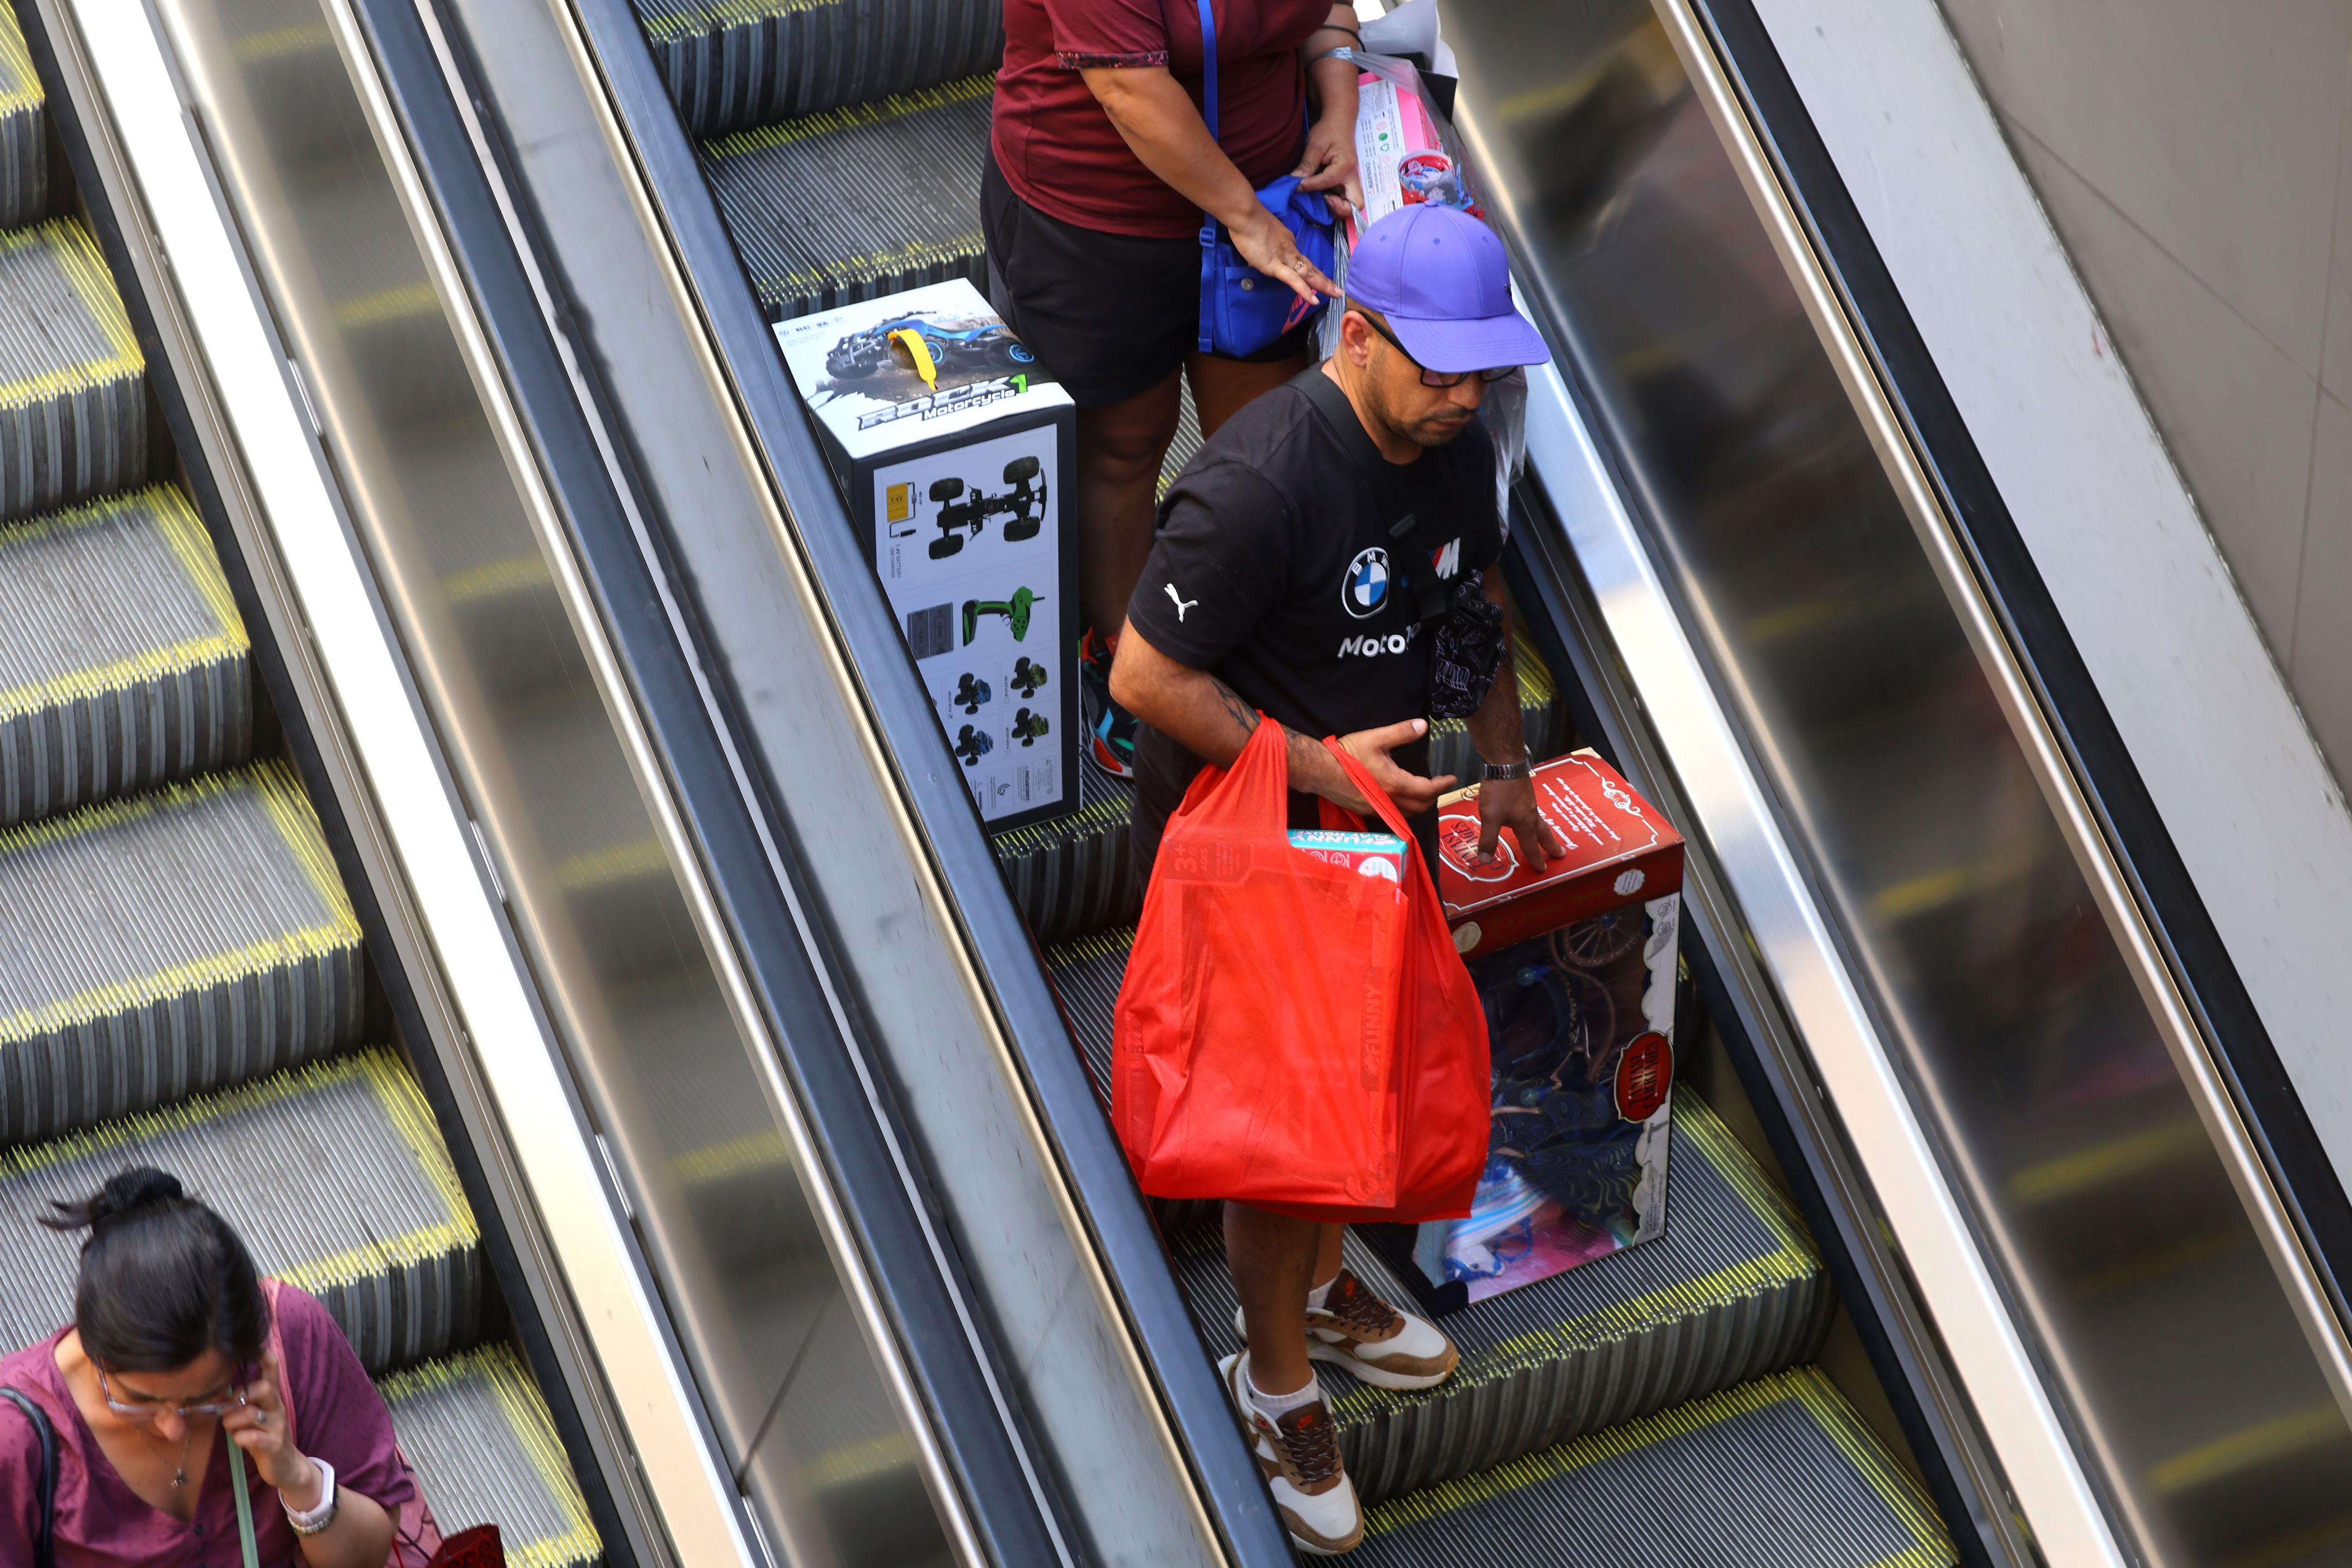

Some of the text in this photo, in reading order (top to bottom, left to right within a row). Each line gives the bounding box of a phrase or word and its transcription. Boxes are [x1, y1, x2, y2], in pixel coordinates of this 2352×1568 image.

[923, 389, 1016, 420] Motorcycle
[891, 495, 903, 503] 7.4V
[1351, 551, 1388, 577] BMW
[1289, 834, 1371, 844] FUNNY
[1552, 825, 1579, 850] Journey
[1364, 981, 1382, 1056] FUNNY
[1628, 1055, 1643, 1109] FANTASY
[1643, 1040, 1659, 1109] CARRIAGES
